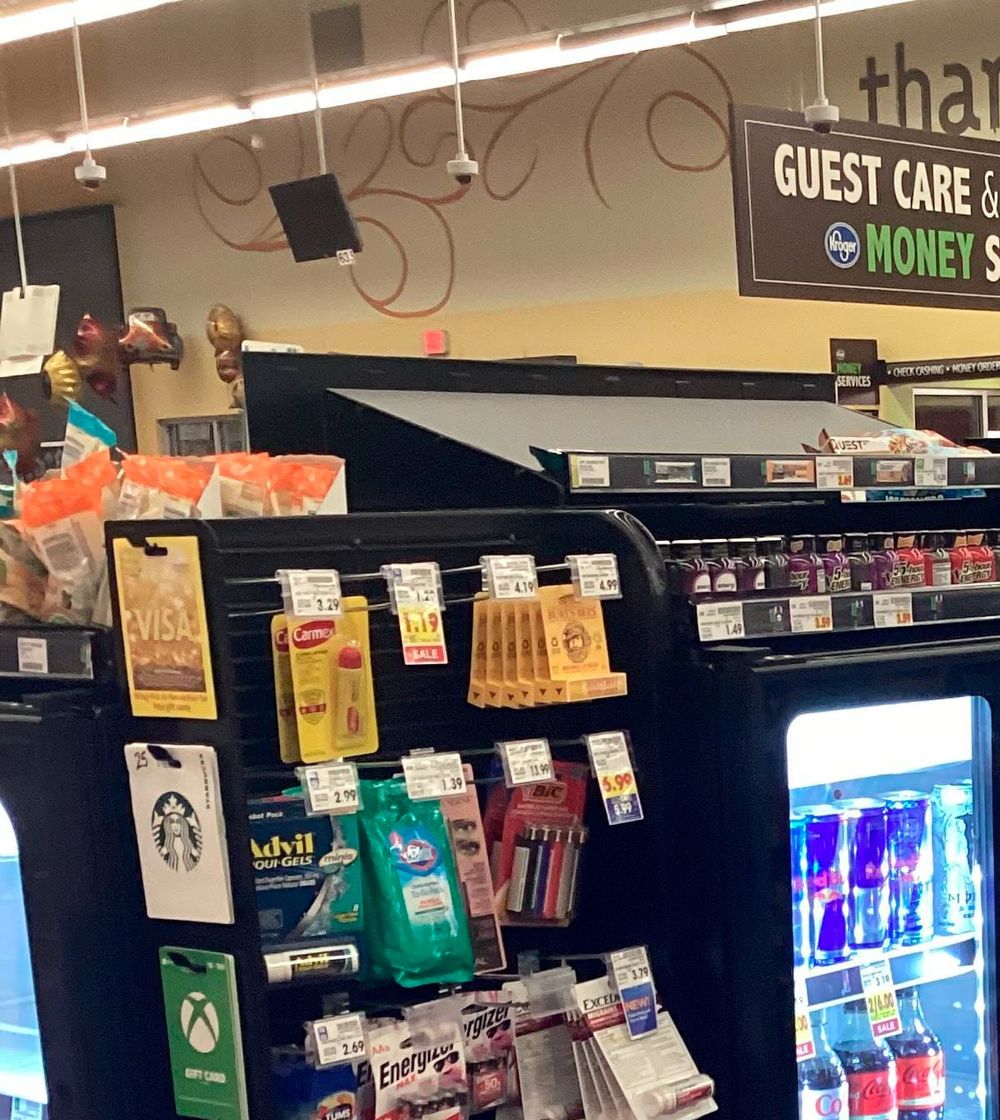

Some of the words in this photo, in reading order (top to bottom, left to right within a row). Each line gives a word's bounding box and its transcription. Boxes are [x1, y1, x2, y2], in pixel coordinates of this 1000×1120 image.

[774, 143, 882, 204] GUEST
[894, 159, 972, 216] CARE
[981, 170, 999, 219] &
[827, 230, 859, 260] Kroger
[866, 223, 975, 281] MONEY
[836, 362, 862, 374] MONEY
[893, 367, 914, 377] CHECK
[915, 364, 945, 376] CASHING
[952, 362, 976, 374] MONEY
[836, 376, 871, 388] SERVICES
[829, 438, 864, 451] QUEST
[514, 581, 534, 593] 4.19
[599, 579, 617, 591] 4.99
[316, 597, 340, 611] 3.29
[136, 609, 193, 642] VISA
[403, 611, 439, 633] 1.19
[412, 648, 438, 659] SALE
[135, 751, 149, 770] 25
[440, 777, 463, 792] 1.39
[532, 785, 563, 798] BIC
[334, 789, 357, 803] 2.99
[631, 966, 649, 981] 3.79
[877, 1021, 896, 1034] SALE
[342, 1040, 364, 1056] 2.69
